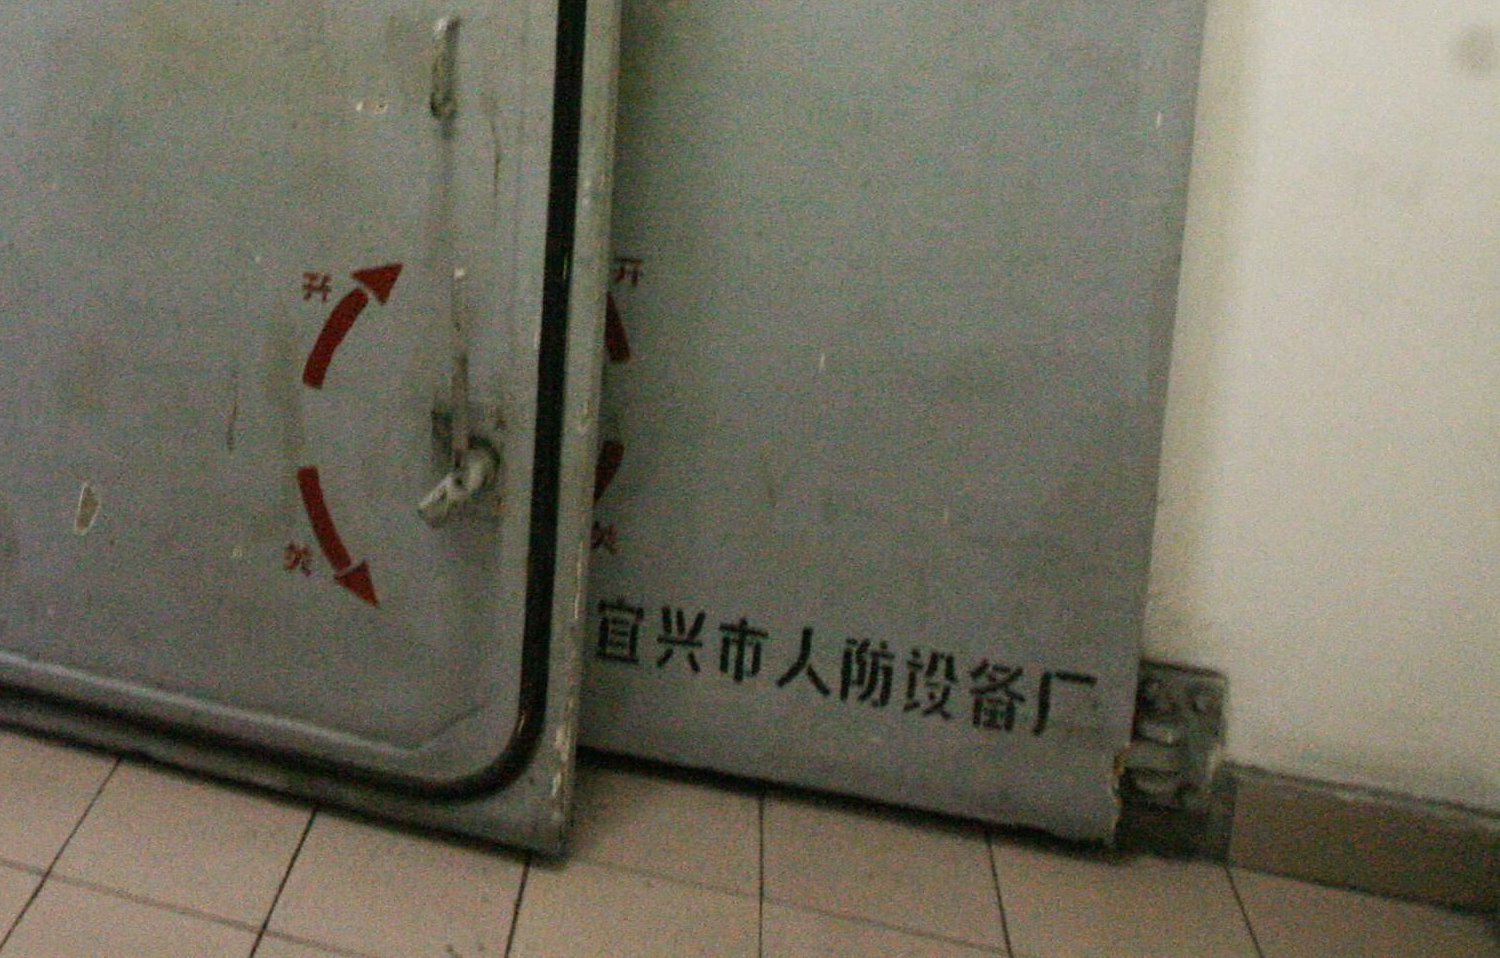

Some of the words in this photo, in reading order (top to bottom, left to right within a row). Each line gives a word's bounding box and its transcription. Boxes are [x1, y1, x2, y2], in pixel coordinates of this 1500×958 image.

[303, 272, 331, 303] 开
[284, 541, 312, 576] 关
[596, 598, 1098, 735] 宜兴市人防设备厂
